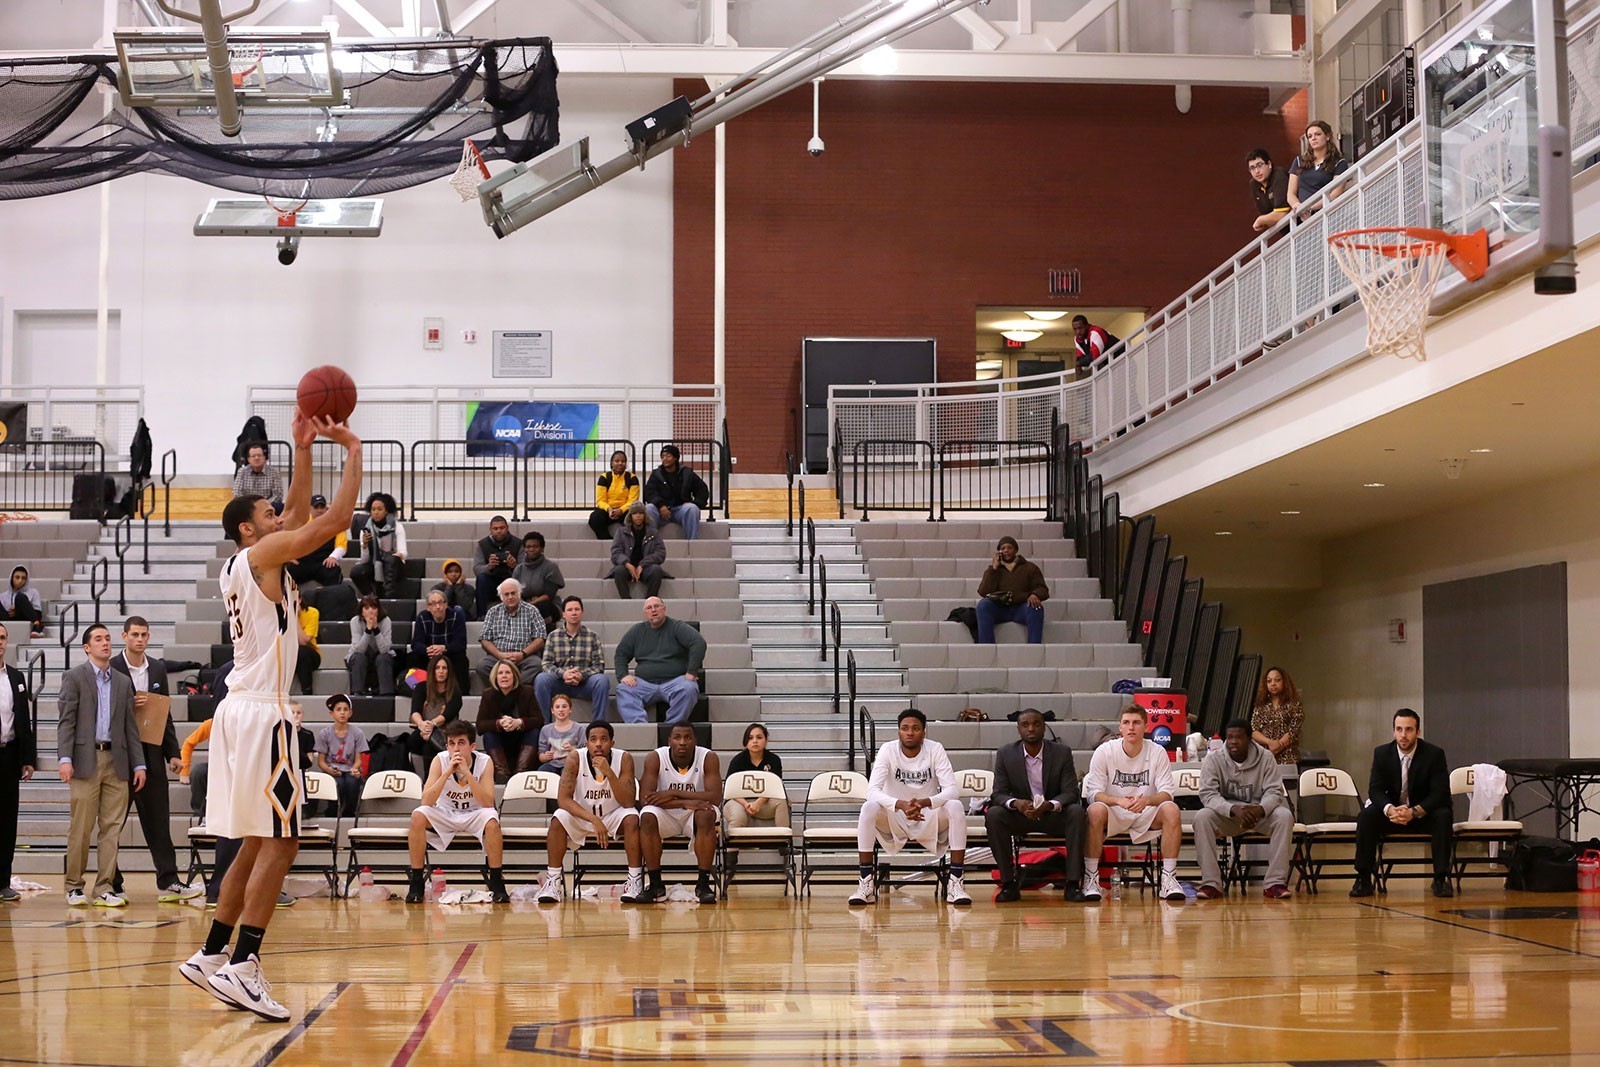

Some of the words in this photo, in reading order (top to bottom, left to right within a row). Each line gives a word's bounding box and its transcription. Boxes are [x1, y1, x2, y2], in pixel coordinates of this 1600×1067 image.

[495, 429, 521, 438] NCAA
[534, 430, 567, 440] Division
[568, 431, 574, 439] II
[895, 768, 932, 779] ADELPHI
[1112, 769, 1150, 786] ADELPHI
[1316, 772, 1337, 790] AU
[382, 774, 406, 792] AU
[524, 775, 547, 793] AU
[742, 775, 765, 793] AU
[829, 775, 852, 793] AU
[962, 773, 986, 792] AU
[446, 790, 474, 799] ADELPH
[584, 789, 612, 800] ADELPHI
[592, 804, 603, 817] 11
